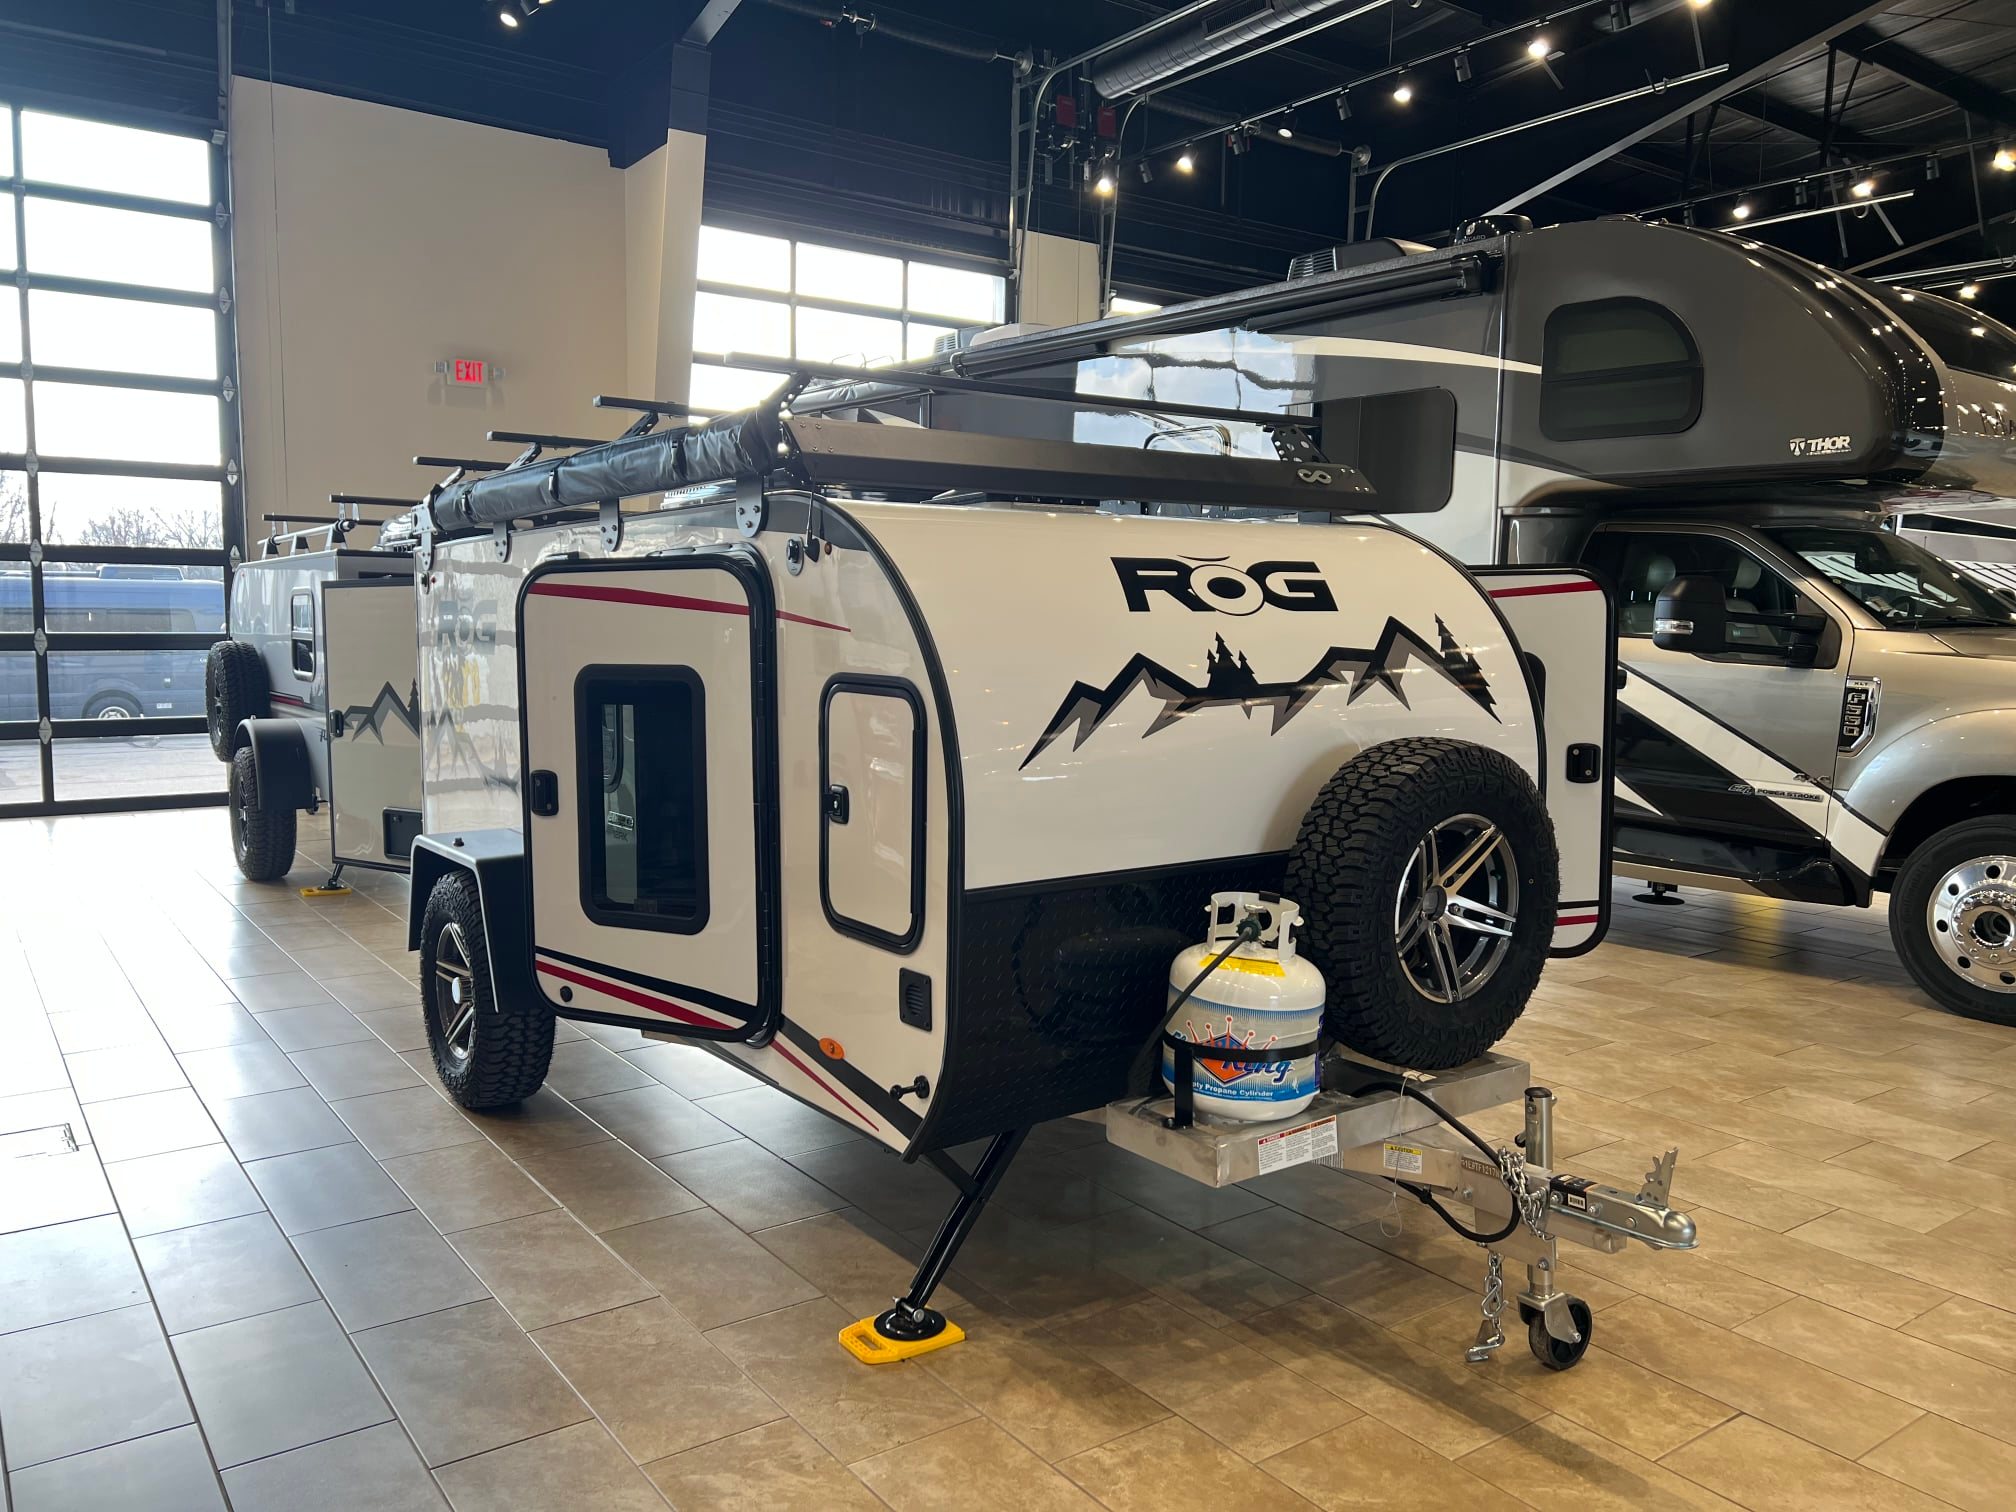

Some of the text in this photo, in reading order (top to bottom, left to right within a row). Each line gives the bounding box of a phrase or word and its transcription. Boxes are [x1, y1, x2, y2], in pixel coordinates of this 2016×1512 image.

[455, 359, 483, 384] EXIT
[1807, 436, 1850, 451] THOR
[1110, 555, 1339, 616] ROG
[1205, 1083, 1237, 1096] Propane
